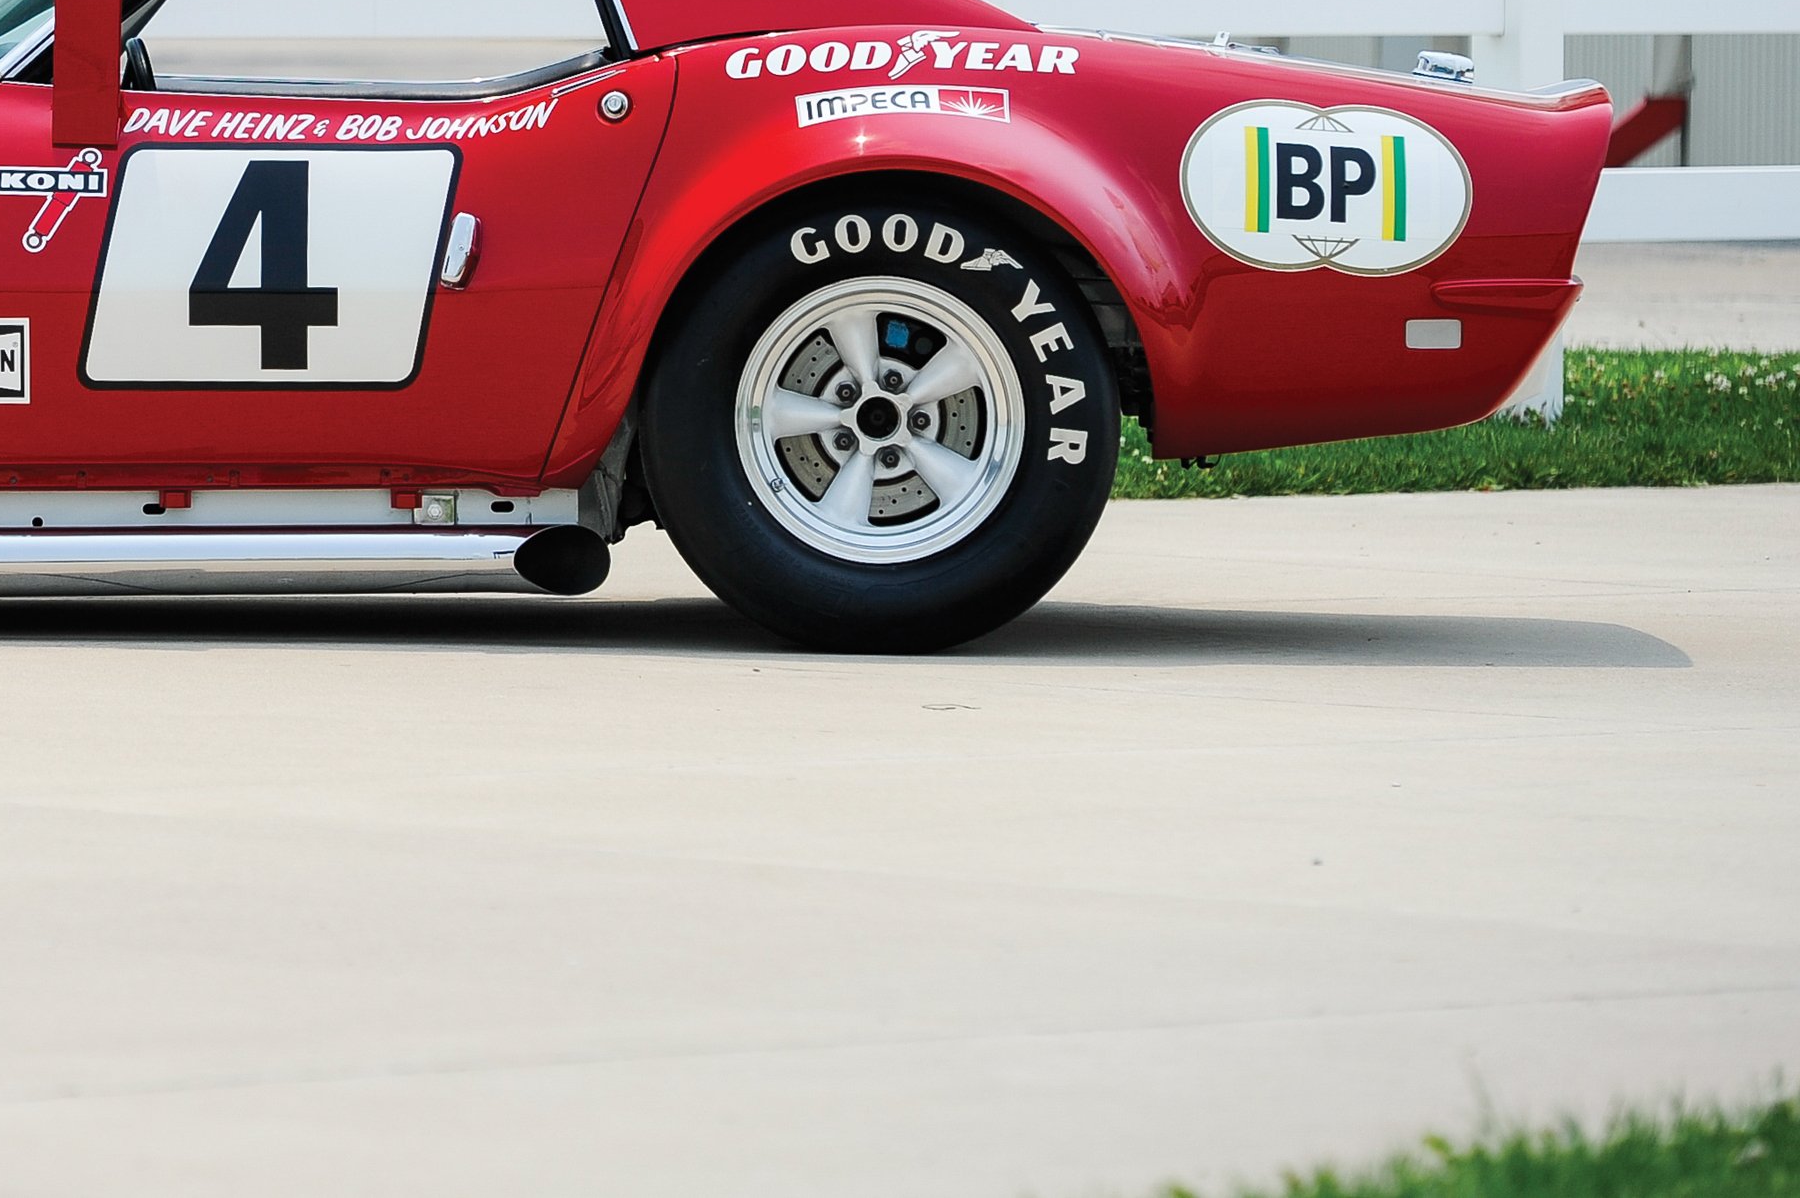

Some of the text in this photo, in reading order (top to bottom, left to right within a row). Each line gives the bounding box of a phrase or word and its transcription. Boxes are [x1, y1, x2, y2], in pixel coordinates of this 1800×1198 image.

[123, 108, 213, 138] DAVE
[211, 112, 315, 140] HEINZ
[336, 114, 400, 141] BOB
[406, 99, 558, 140] JOHNSON
[806, 90, 931, 121] IMPECA
[0, 172, 100, 191] KONI
[1276, 142, 1376, 223] BP
[188, 159, 338, 370] 4
